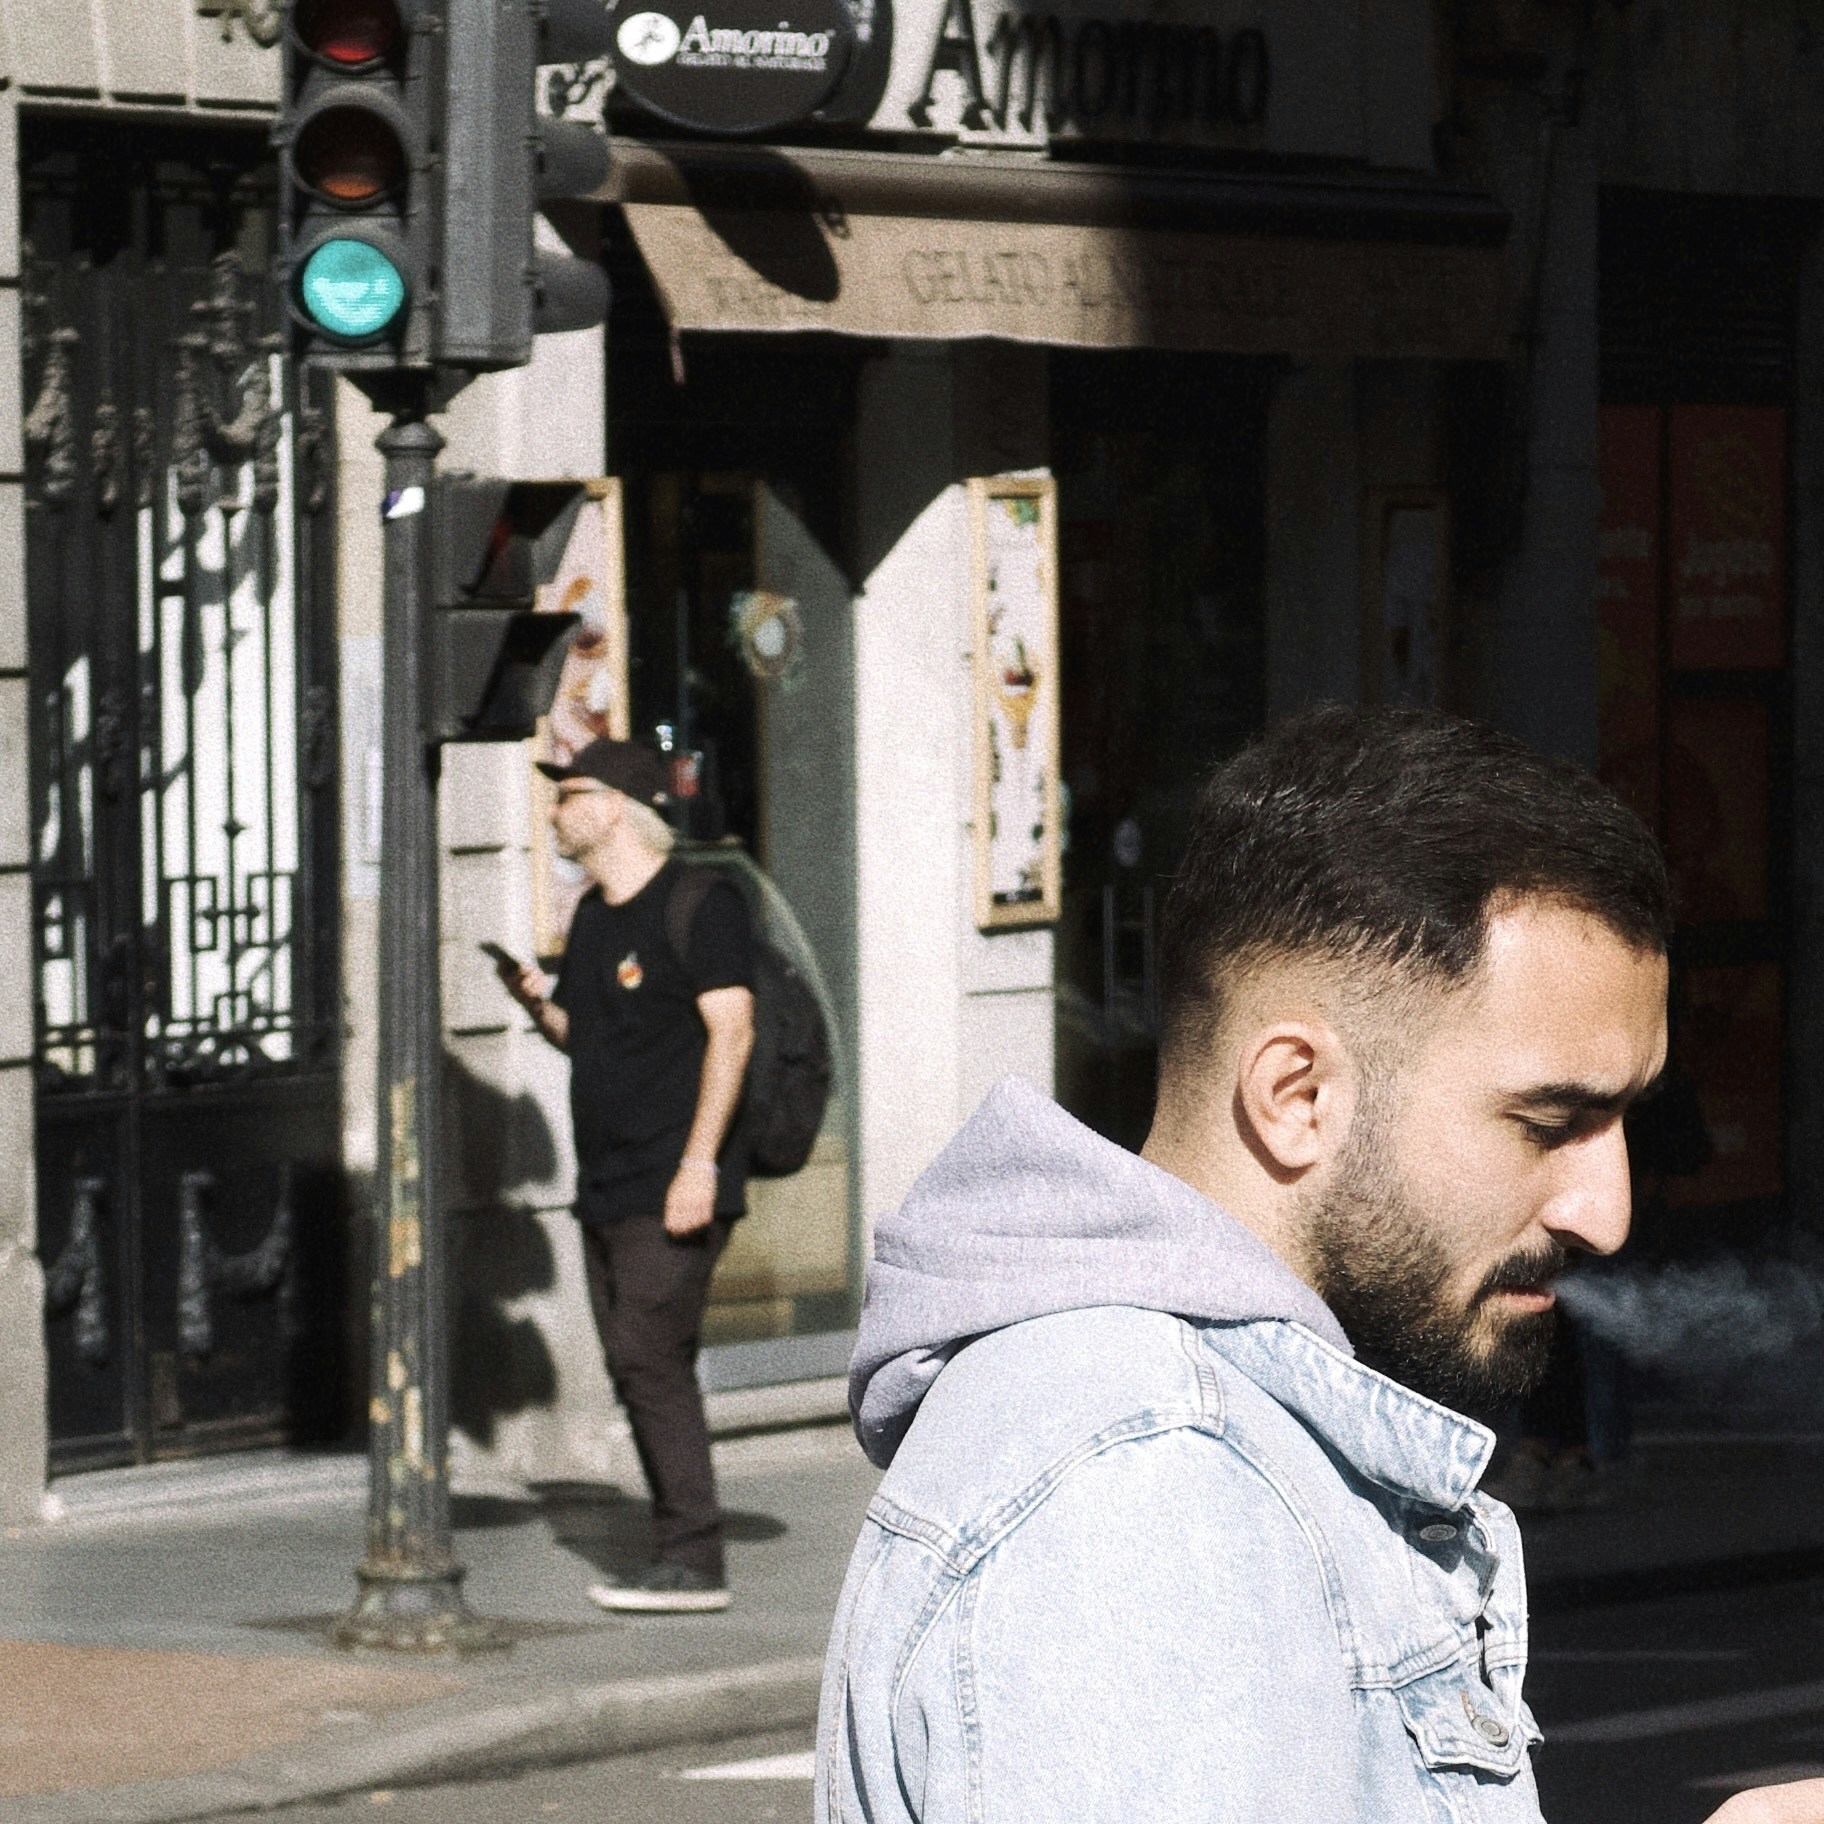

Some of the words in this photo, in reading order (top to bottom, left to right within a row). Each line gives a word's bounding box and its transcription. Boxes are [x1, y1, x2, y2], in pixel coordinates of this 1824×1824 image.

[677, 14, 829, 57] Amorino
[907, 0, 1270, 132] Amorino
[903, 248, 1051, 307] GELATO
